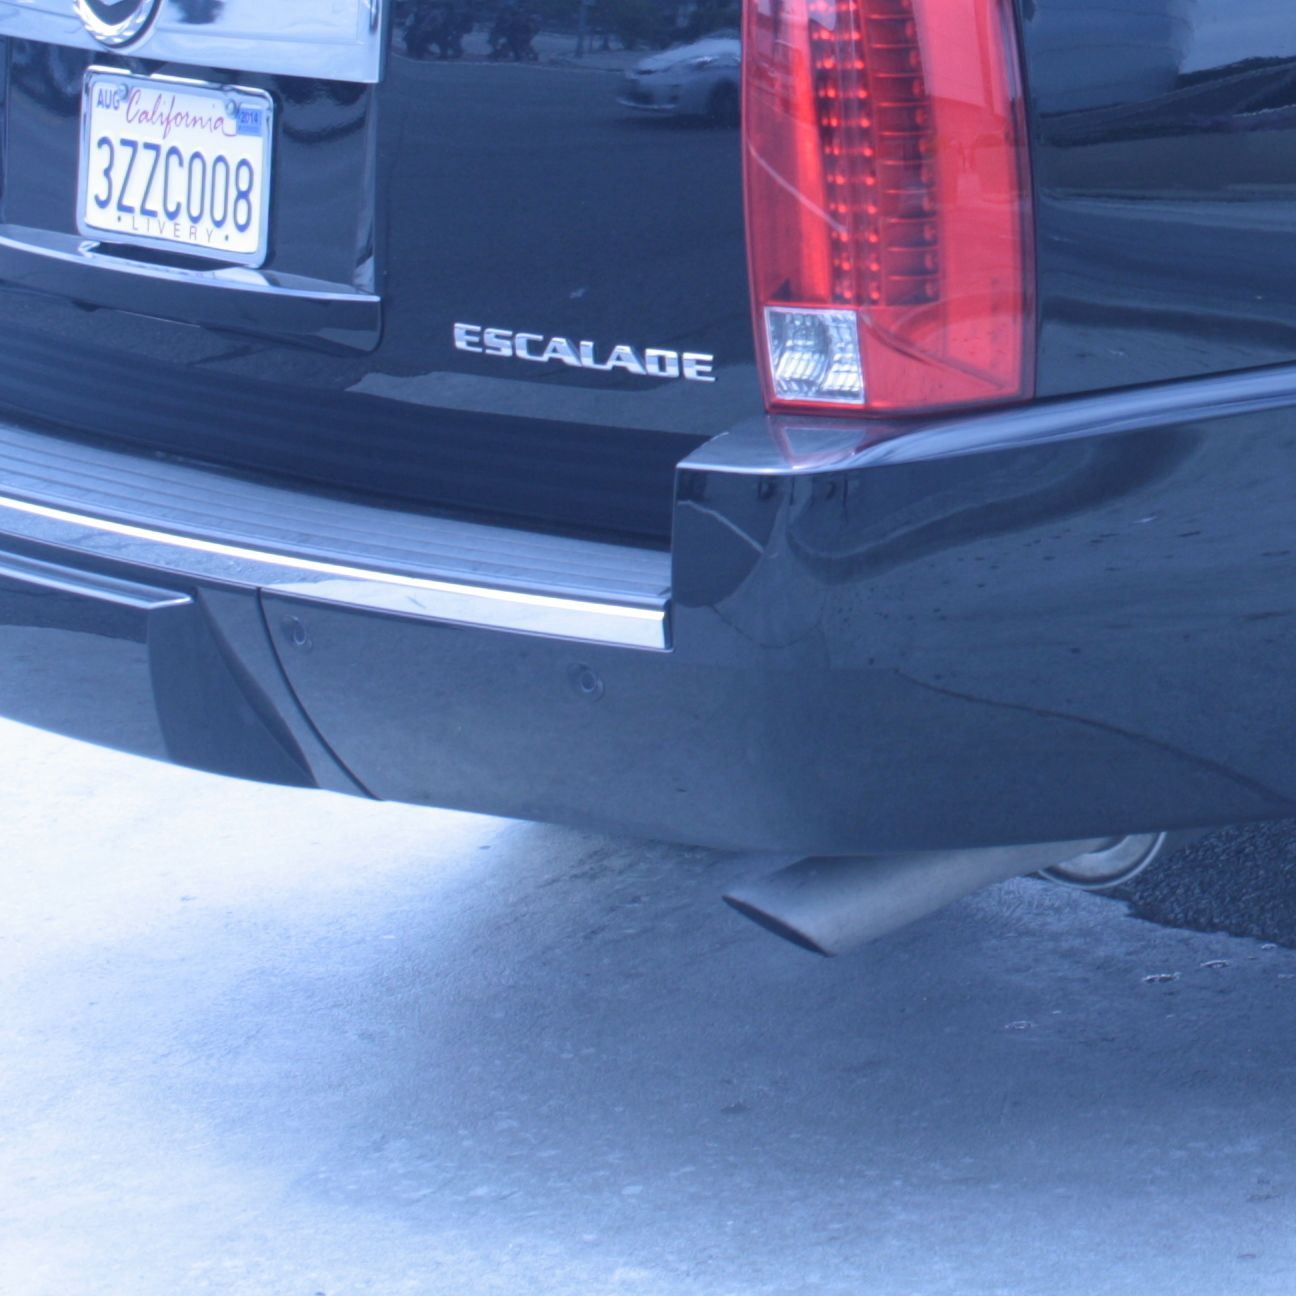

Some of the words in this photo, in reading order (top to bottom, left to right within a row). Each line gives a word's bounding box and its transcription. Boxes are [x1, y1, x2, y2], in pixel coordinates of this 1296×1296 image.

[96, 88, 120, 111] AUG
[125, 88, 237, 140] California
[94, 135, 255, 233] 3ZZC008
[131, 215, 216, 243] LIVERY
[453, 321, 717, 383] ESCALADE
